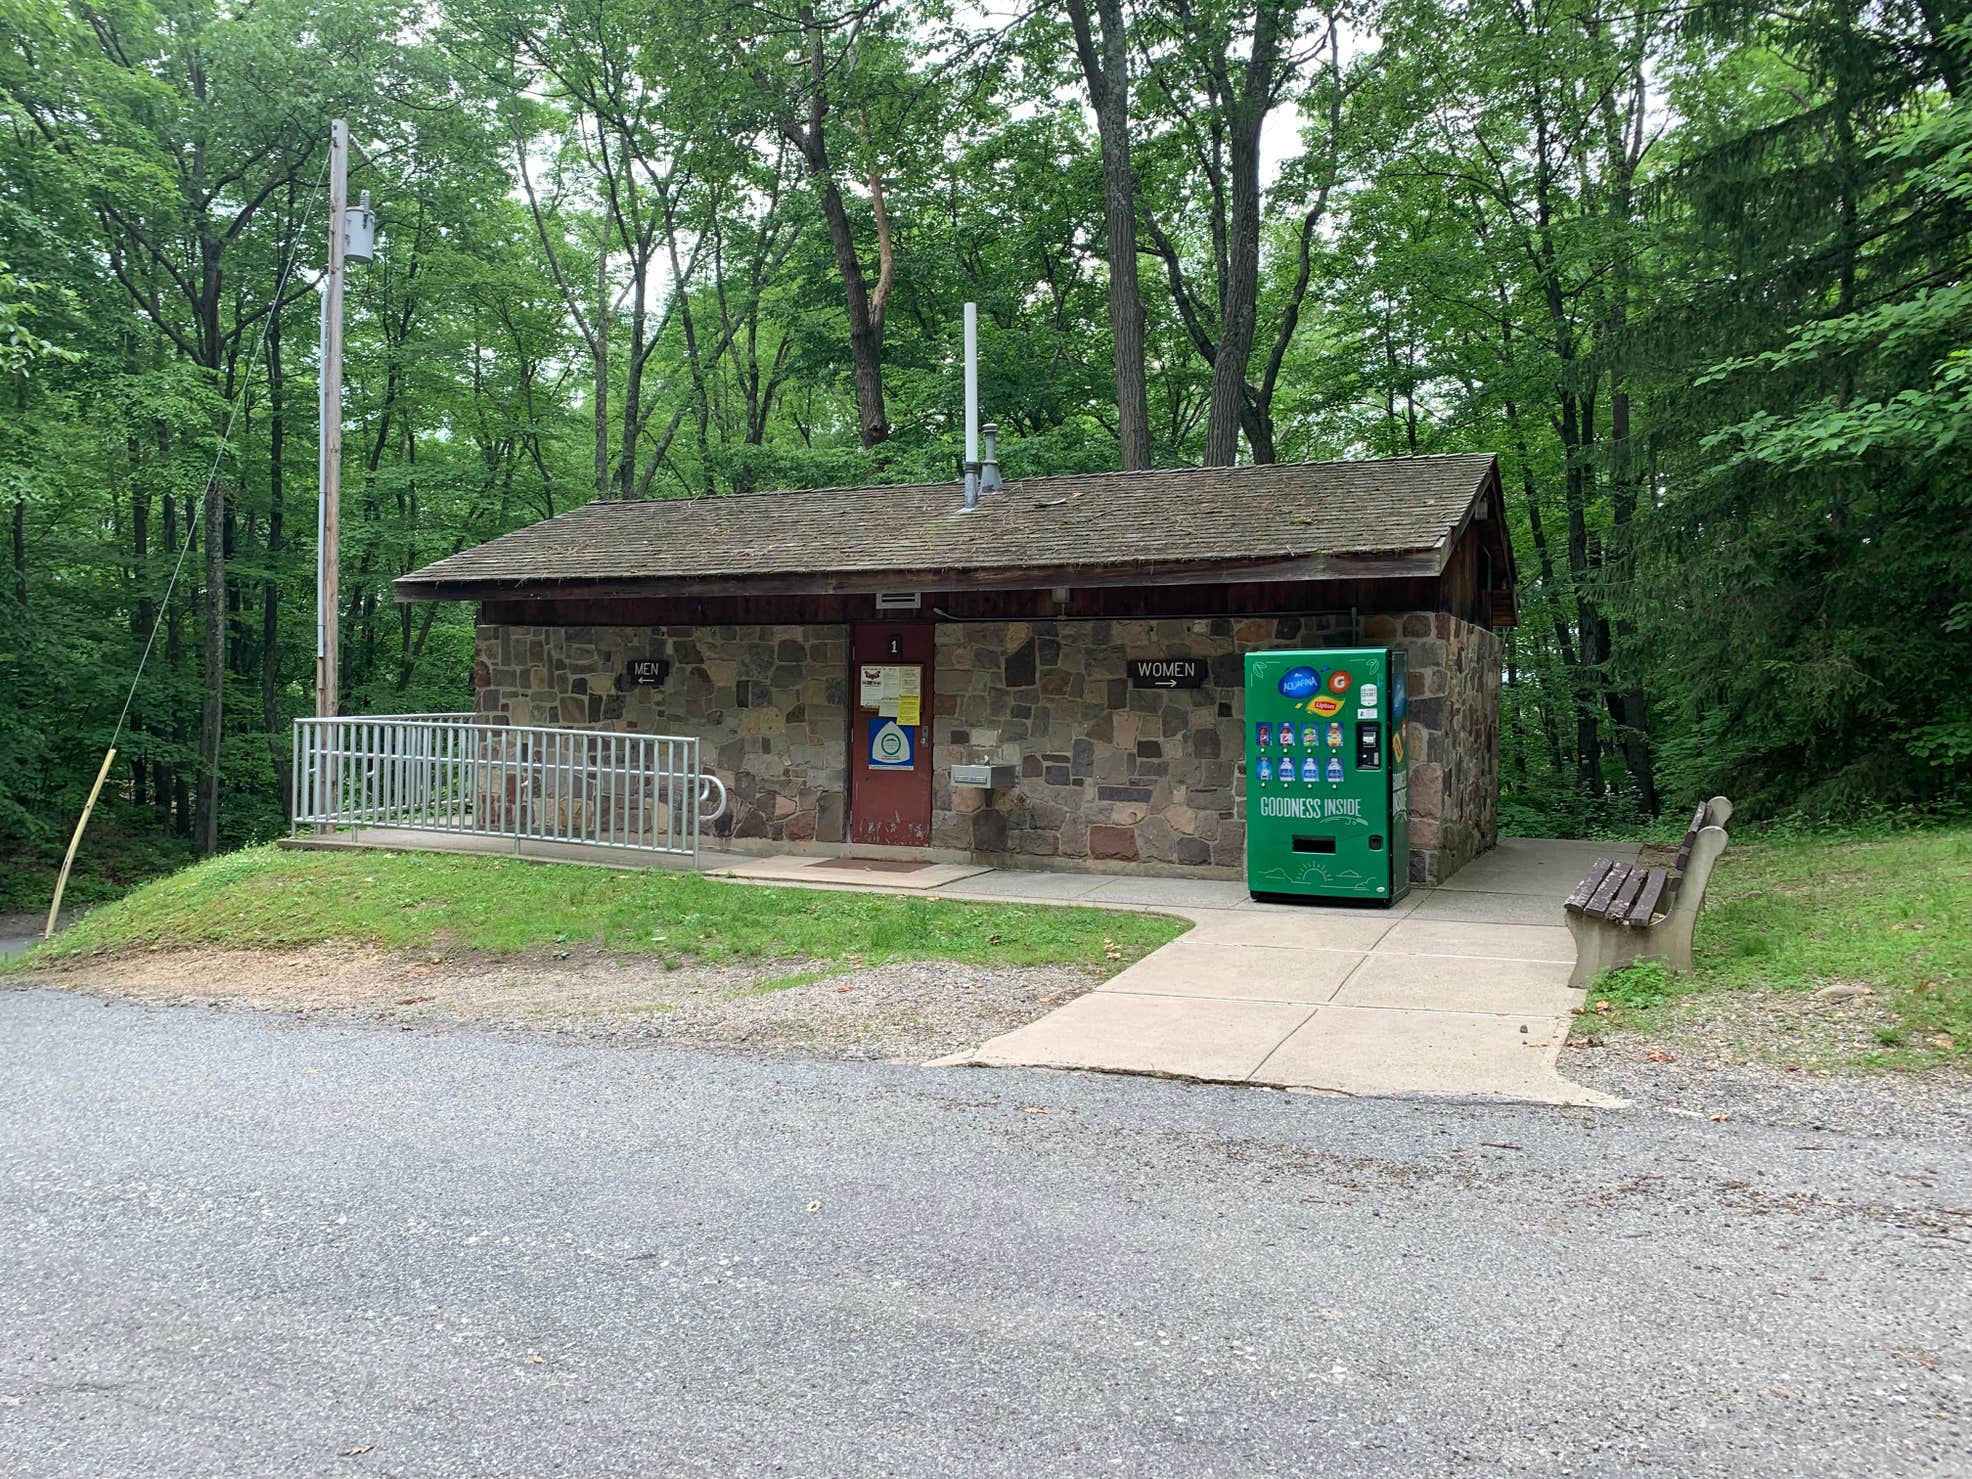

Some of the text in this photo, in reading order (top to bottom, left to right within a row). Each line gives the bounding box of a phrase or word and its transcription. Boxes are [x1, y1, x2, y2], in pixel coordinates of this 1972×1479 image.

[890, 639, 898, 653] 1
[634, 662, 659, 675] MEN
[1138, 662, 1195, 677] WOMEN
[1283, 676, 1318, 692] AQUAFINA
[1333, 675, 1345, 688] G
[1316, 702, 1335, 710] Lipton
[1260, 796, 1362, 819] GOODNESS INSIDE
